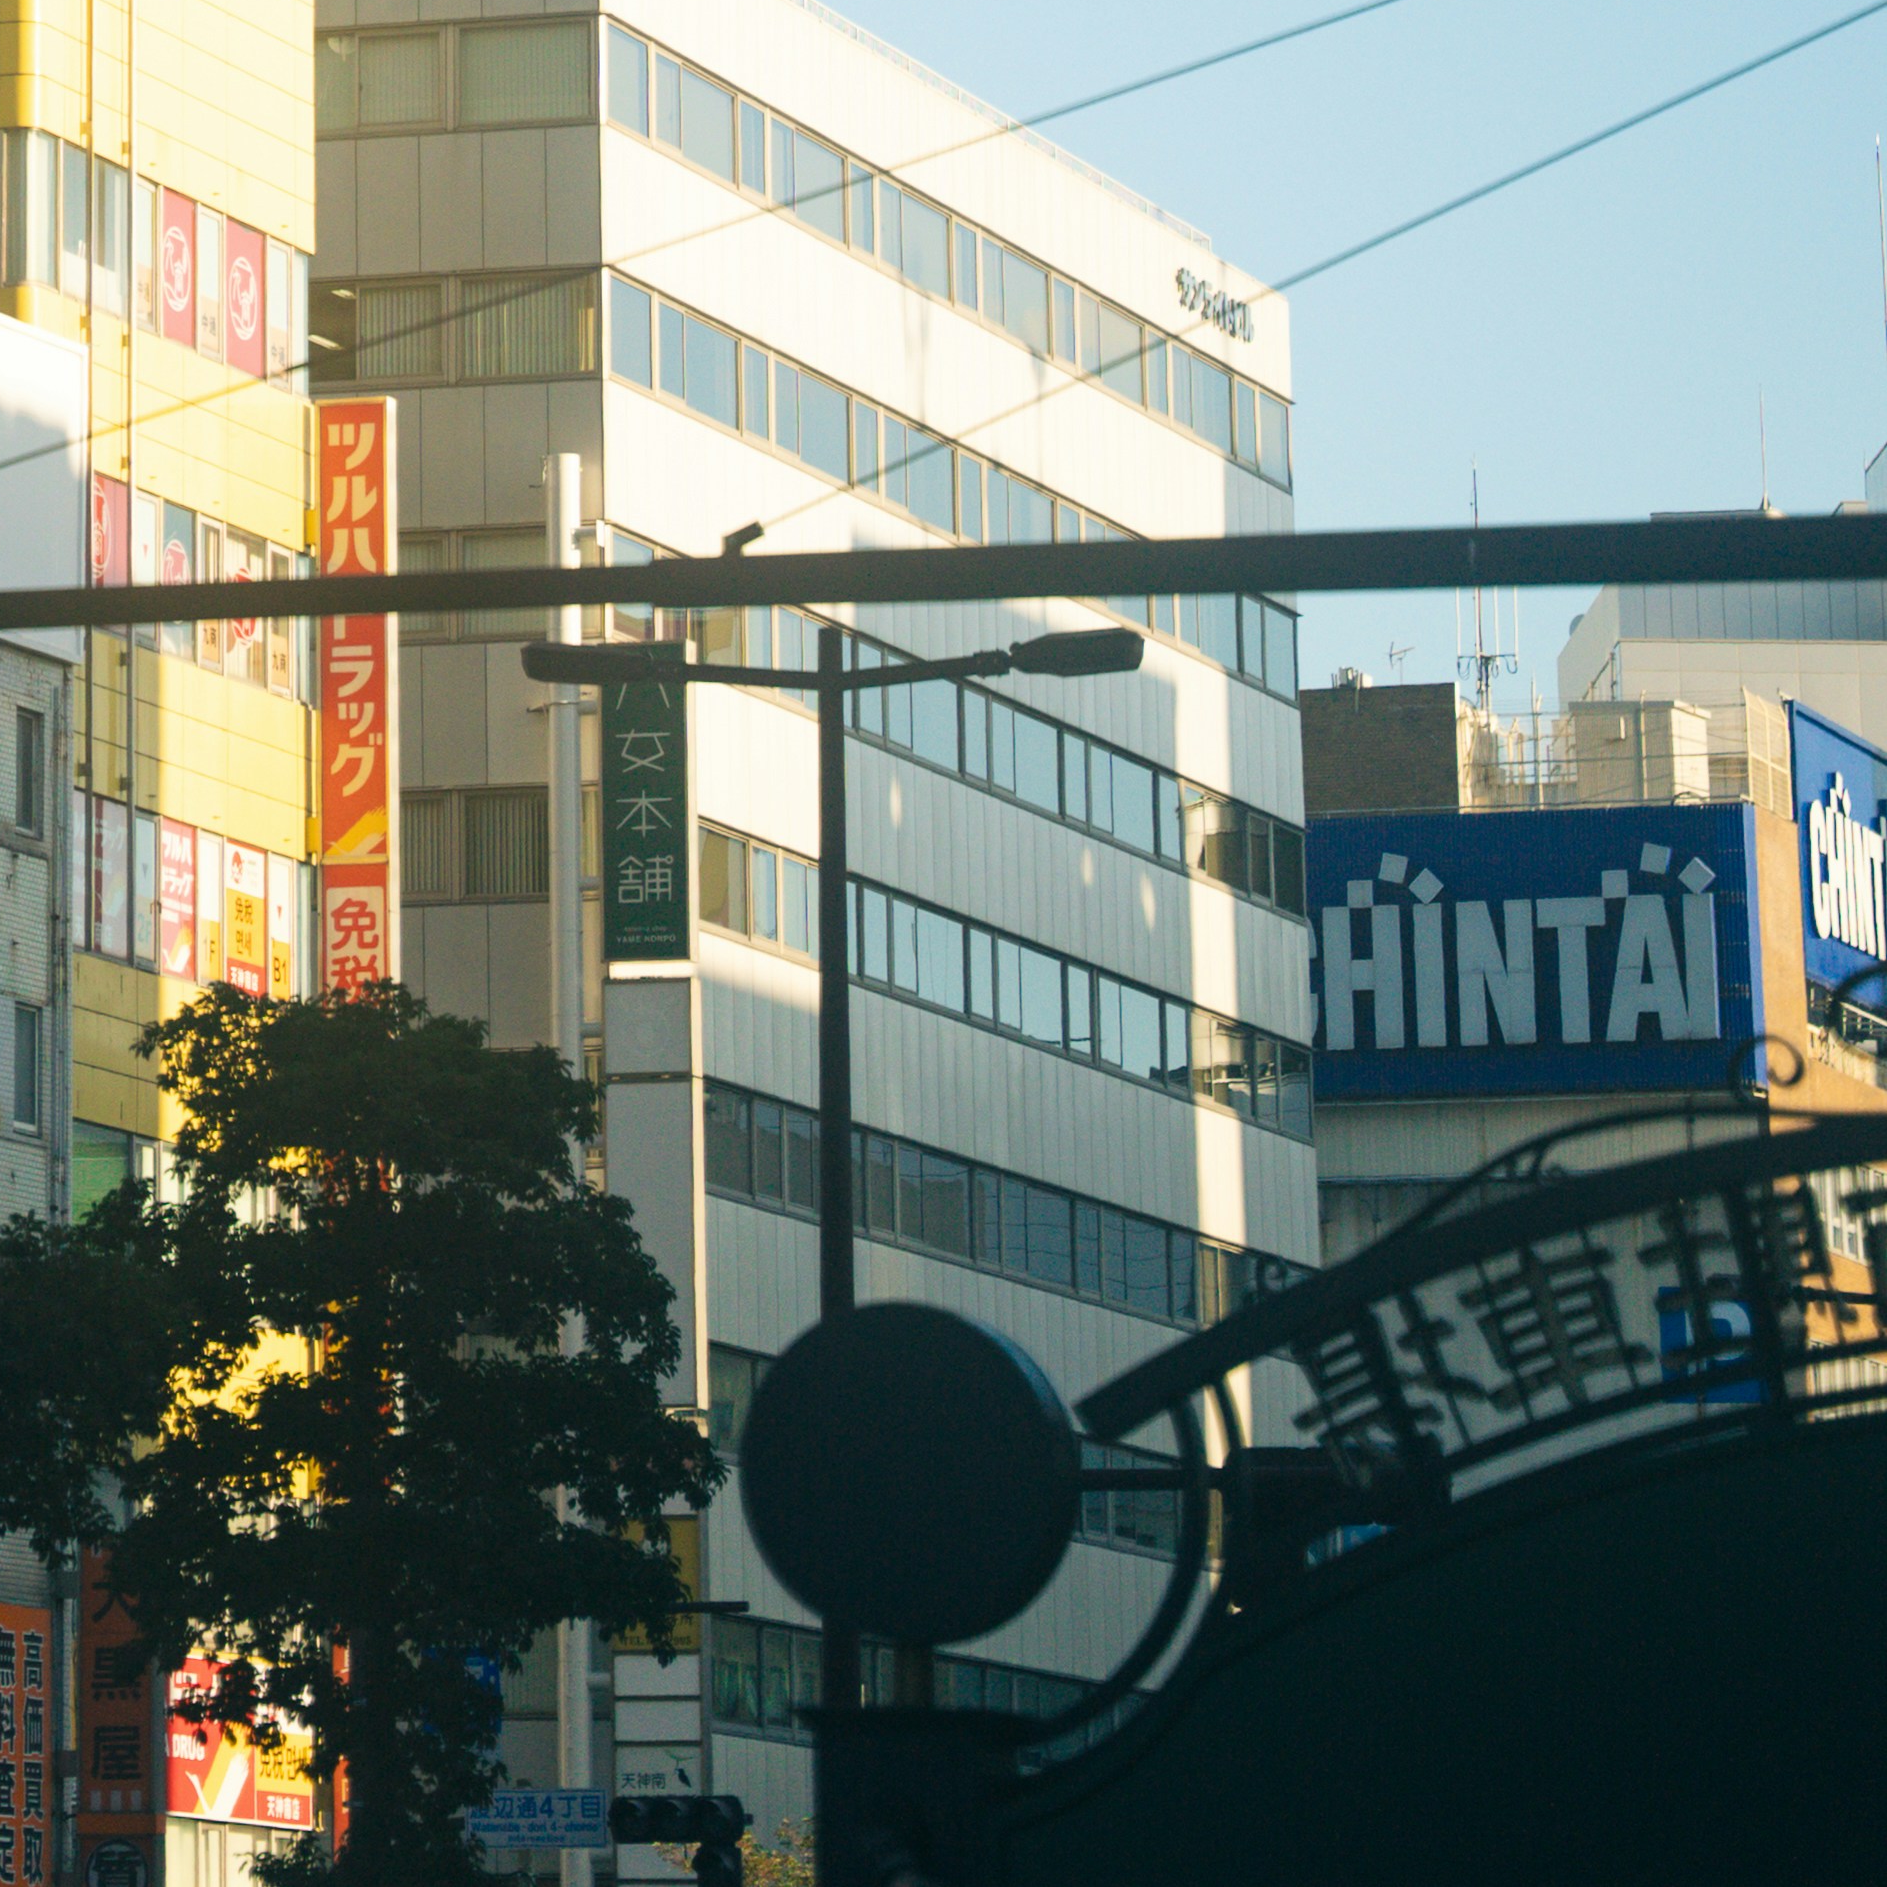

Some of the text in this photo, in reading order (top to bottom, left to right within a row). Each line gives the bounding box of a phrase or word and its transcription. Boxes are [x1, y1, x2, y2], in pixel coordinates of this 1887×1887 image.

[325, 421, 387, 798] ツルハラッグ
[1310, 841, 1721, 1052] HINTAI
[21, 1629, 46, 1887] 高価買取
[171, 1733, 206, 1761] DRUG
[620, 1771, 667, 1791] 天神南
